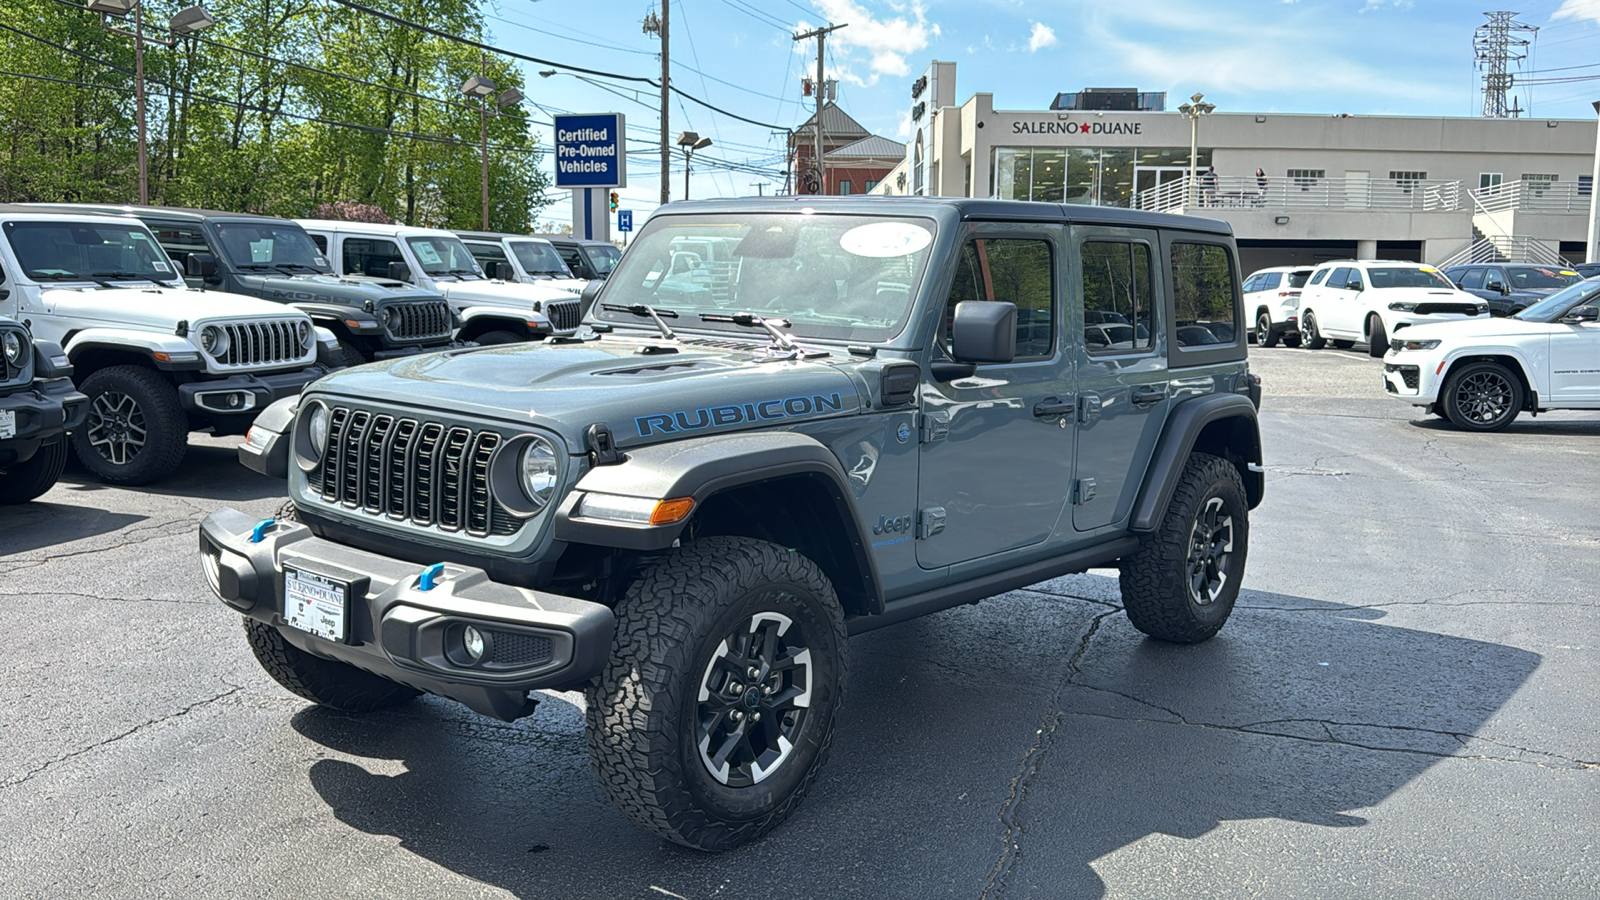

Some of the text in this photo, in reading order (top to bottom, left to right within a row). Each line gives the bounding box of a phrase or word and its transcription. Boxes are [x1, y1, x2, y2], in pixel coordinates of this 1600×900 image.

[1012, 121, 1142, 134] SALERNO DUANE
[558, 128, 607, 142] Certified
[558, 144, 615, 157] Pre-Owned
[559, 160, 608, 173] Vehicles
[621, 215, 629, 226] H
[273, 289, 351, 304] MOAB
[634, 392, 843, 437] RUBICON
[872, 514, 912, 535] Jeep
[287, 579, 343, 606] SALERNO DUANE
[320, 615, 336, 628] Jeep
